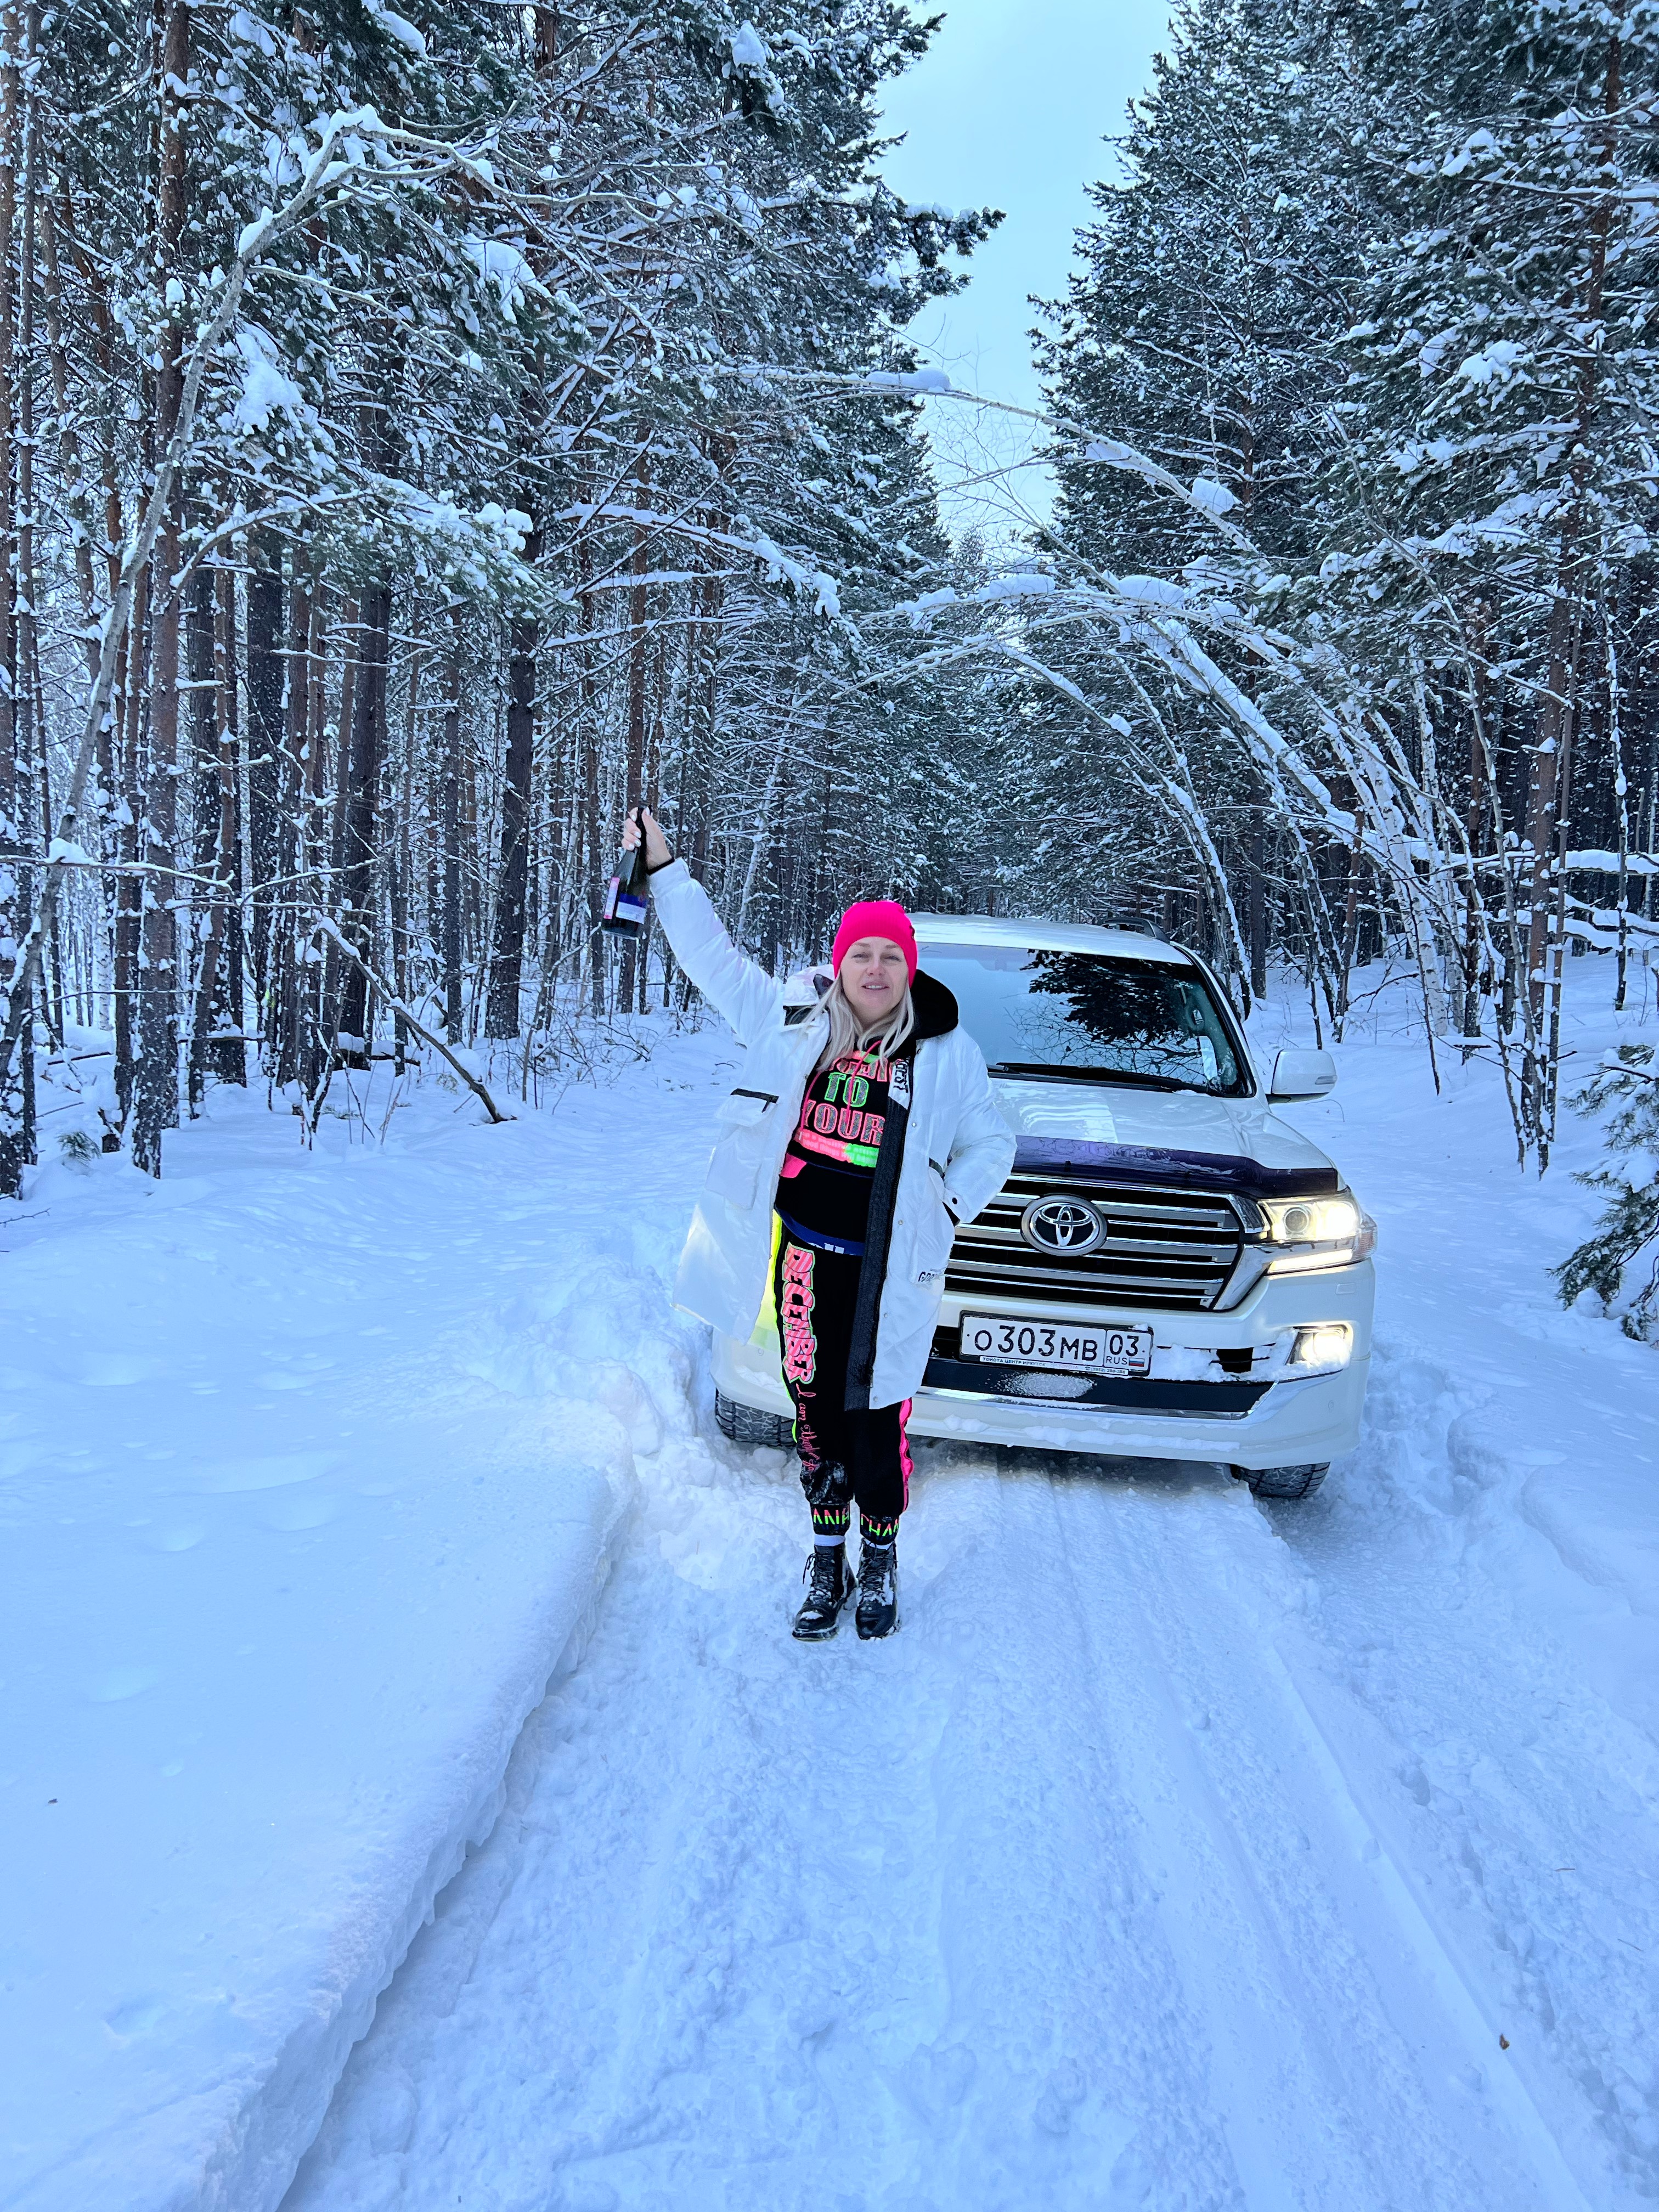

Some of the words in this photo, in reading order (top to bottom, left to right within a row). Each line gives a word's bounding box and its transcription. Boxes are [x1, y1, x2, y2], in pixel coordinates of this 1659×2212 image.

[824, 1071, 870, 1108] TO
[803, 1099, 885, 1146] YOUR
[781, 1242, 817, 1384] DECEMBER
[1106, 1356, 1127, 1365] RUS
[1109, 1334, 1139, 1357] 03
[798, 1403, 806, 1422] am
